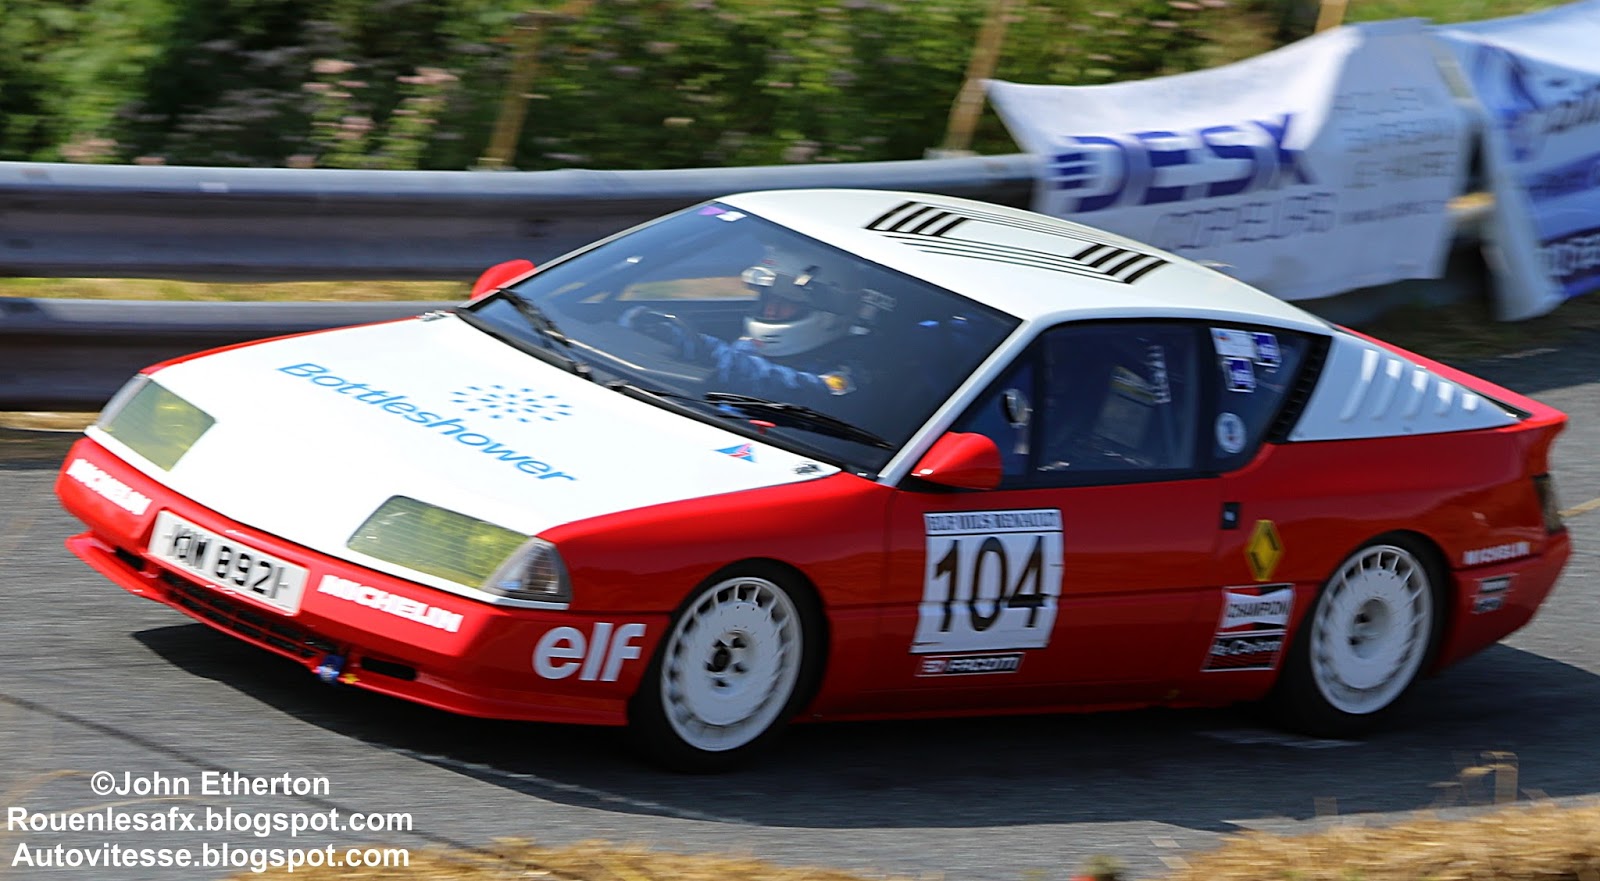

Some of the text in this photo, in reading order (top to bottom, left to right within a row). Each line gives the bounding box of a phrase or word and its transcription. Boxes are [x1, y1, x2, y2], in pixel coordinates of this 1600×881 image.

[278, 362, 577, 481] Bottleshower
[65, 458, 153, 516] MICHELIN
[1462, 541, 1531, 565] MICHELIN
[316, 574, 464, 633] MICHELIN
[934, 535, 1047, 633] 104
[1227, 601, 1289, 618] CHAMPION
[532, 622, 647, 682] elf
